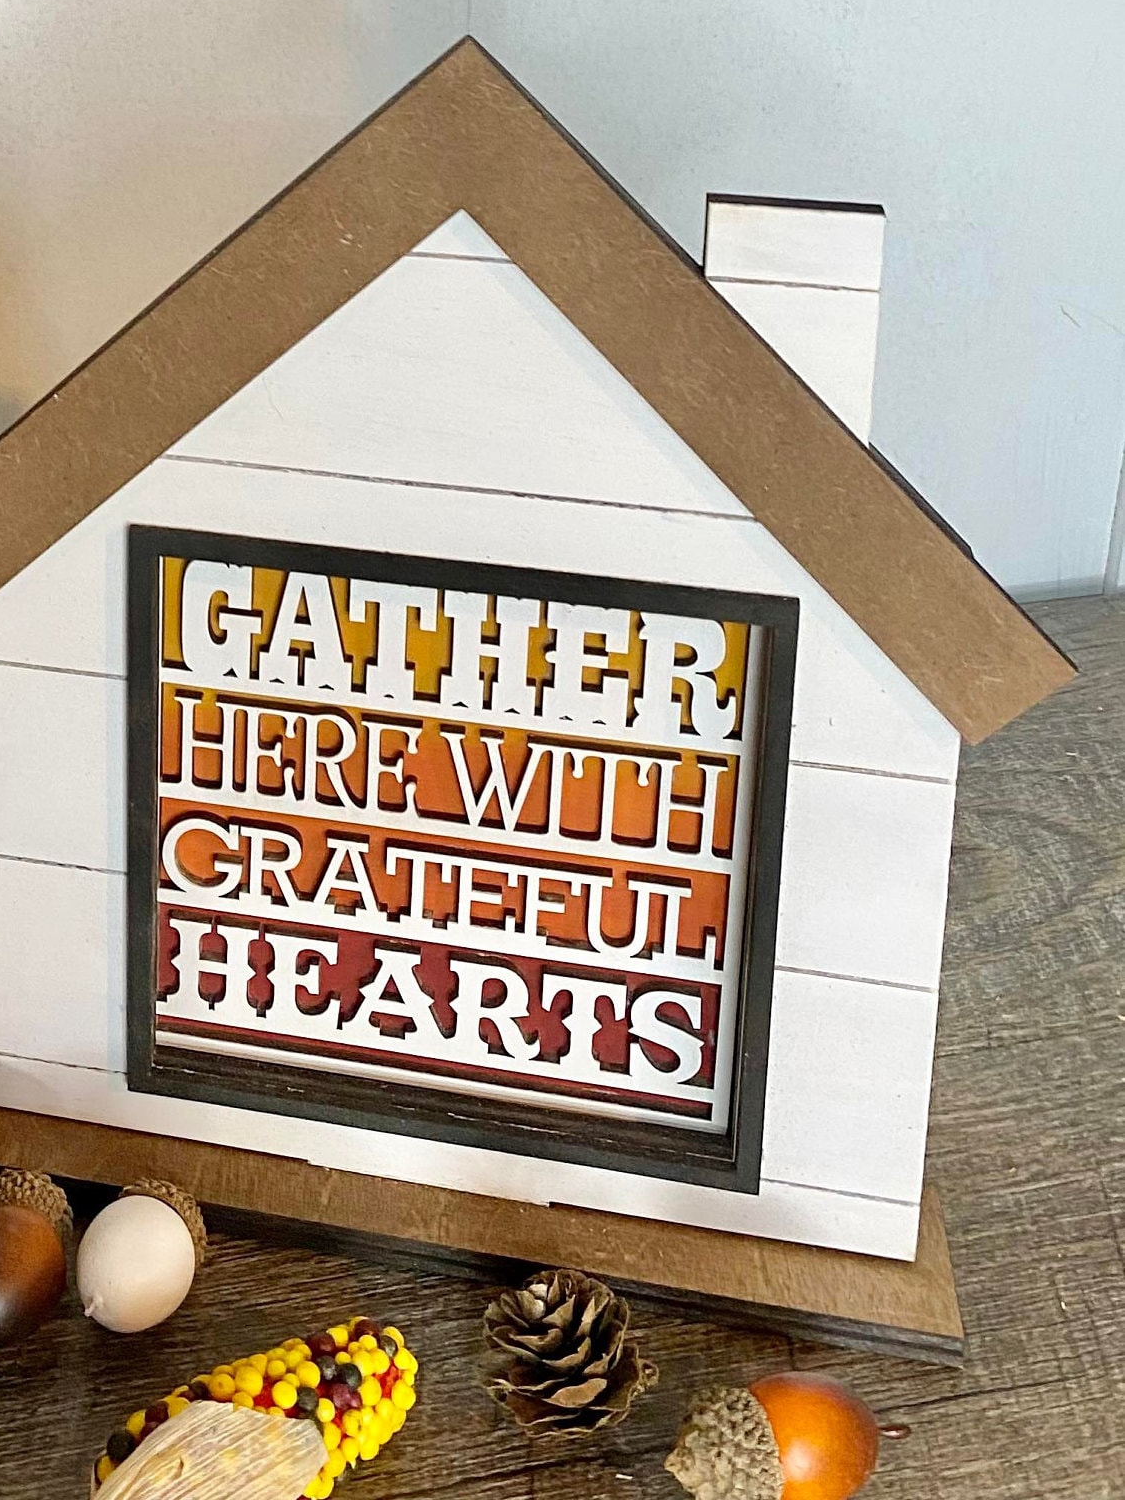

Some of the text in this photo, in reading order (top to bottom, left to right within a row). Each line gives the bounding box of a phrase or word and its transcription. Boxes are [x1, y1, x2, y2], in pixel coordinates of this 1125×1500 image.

[179, 559, 741, 740] GATHER
[172, 695, 736, 859] HERE WITH
[161, 817, 723, 970] GRATEFUL
[167, 918, 705, 1084] HEARTS
